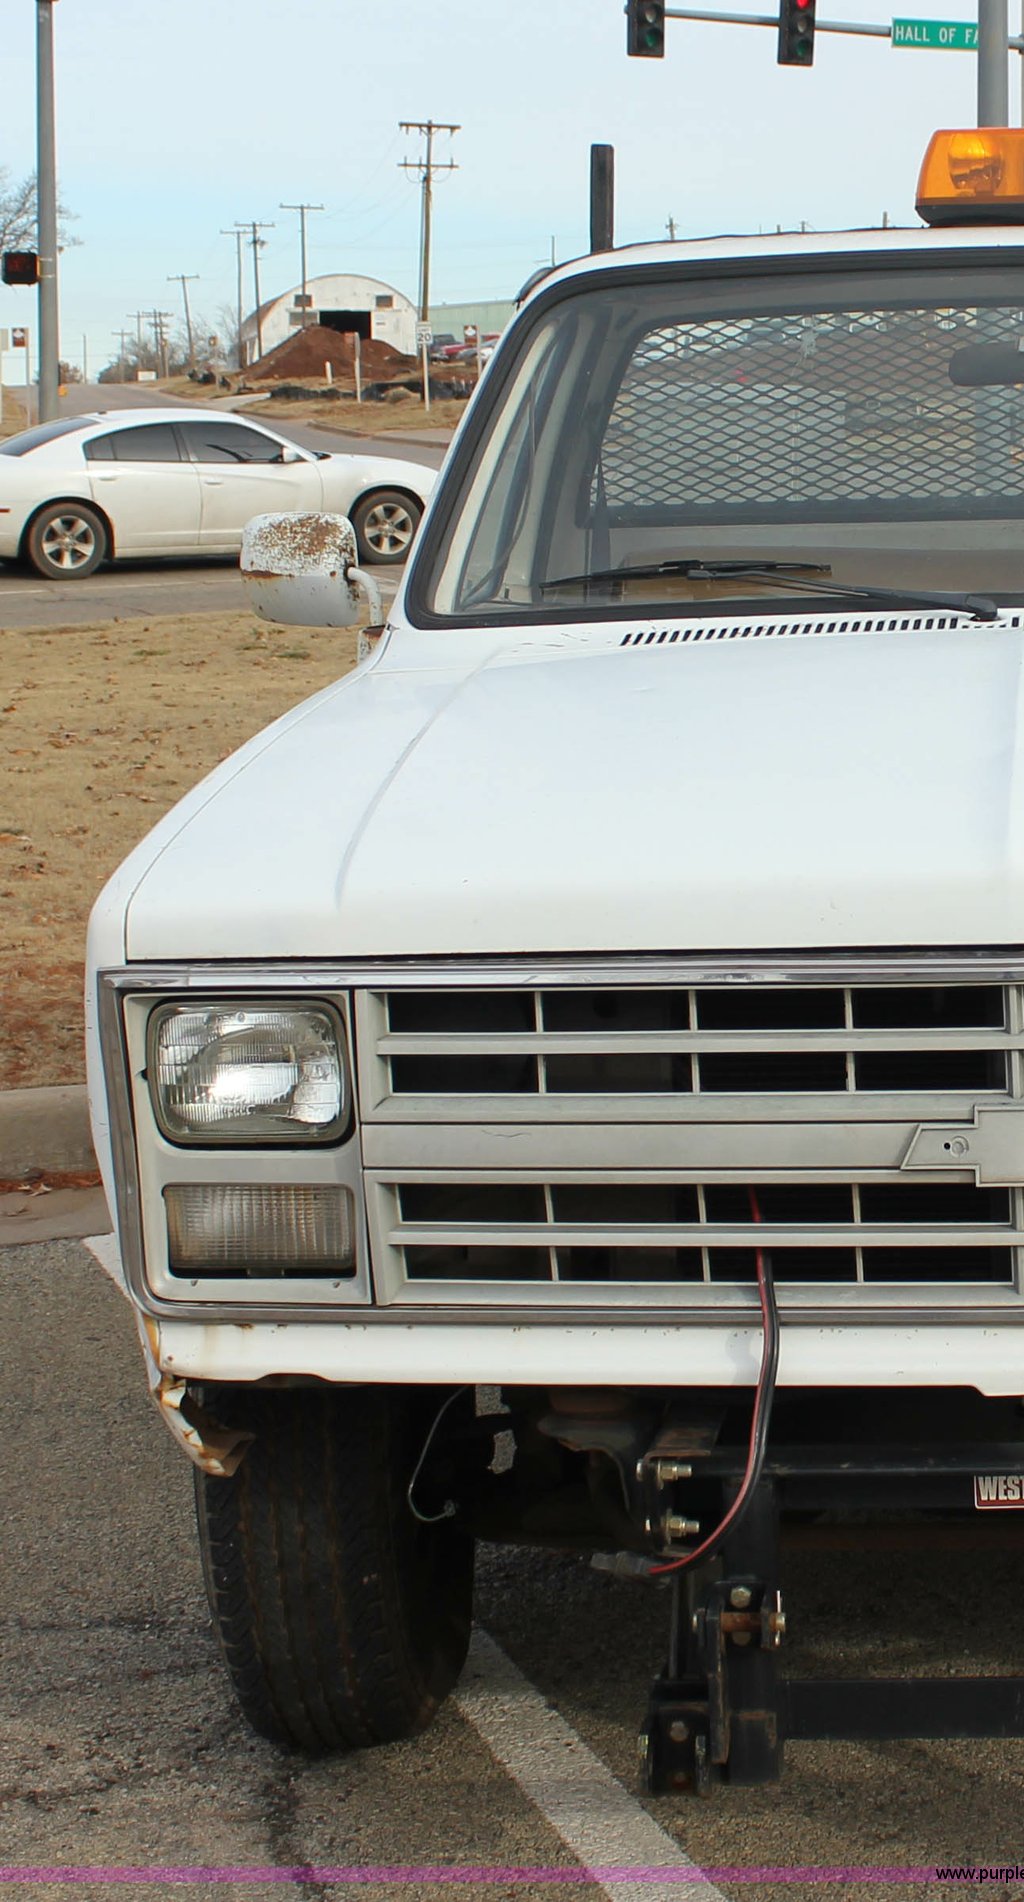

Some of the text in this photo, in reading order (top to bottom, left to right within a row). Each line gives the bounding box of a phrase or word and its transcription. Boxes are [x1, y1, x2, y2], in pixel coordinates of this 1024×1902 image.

[895, 25, 930, 42] HALL
[939, 27, 956, 43] OF
[417, 332, 431, 342] 20
